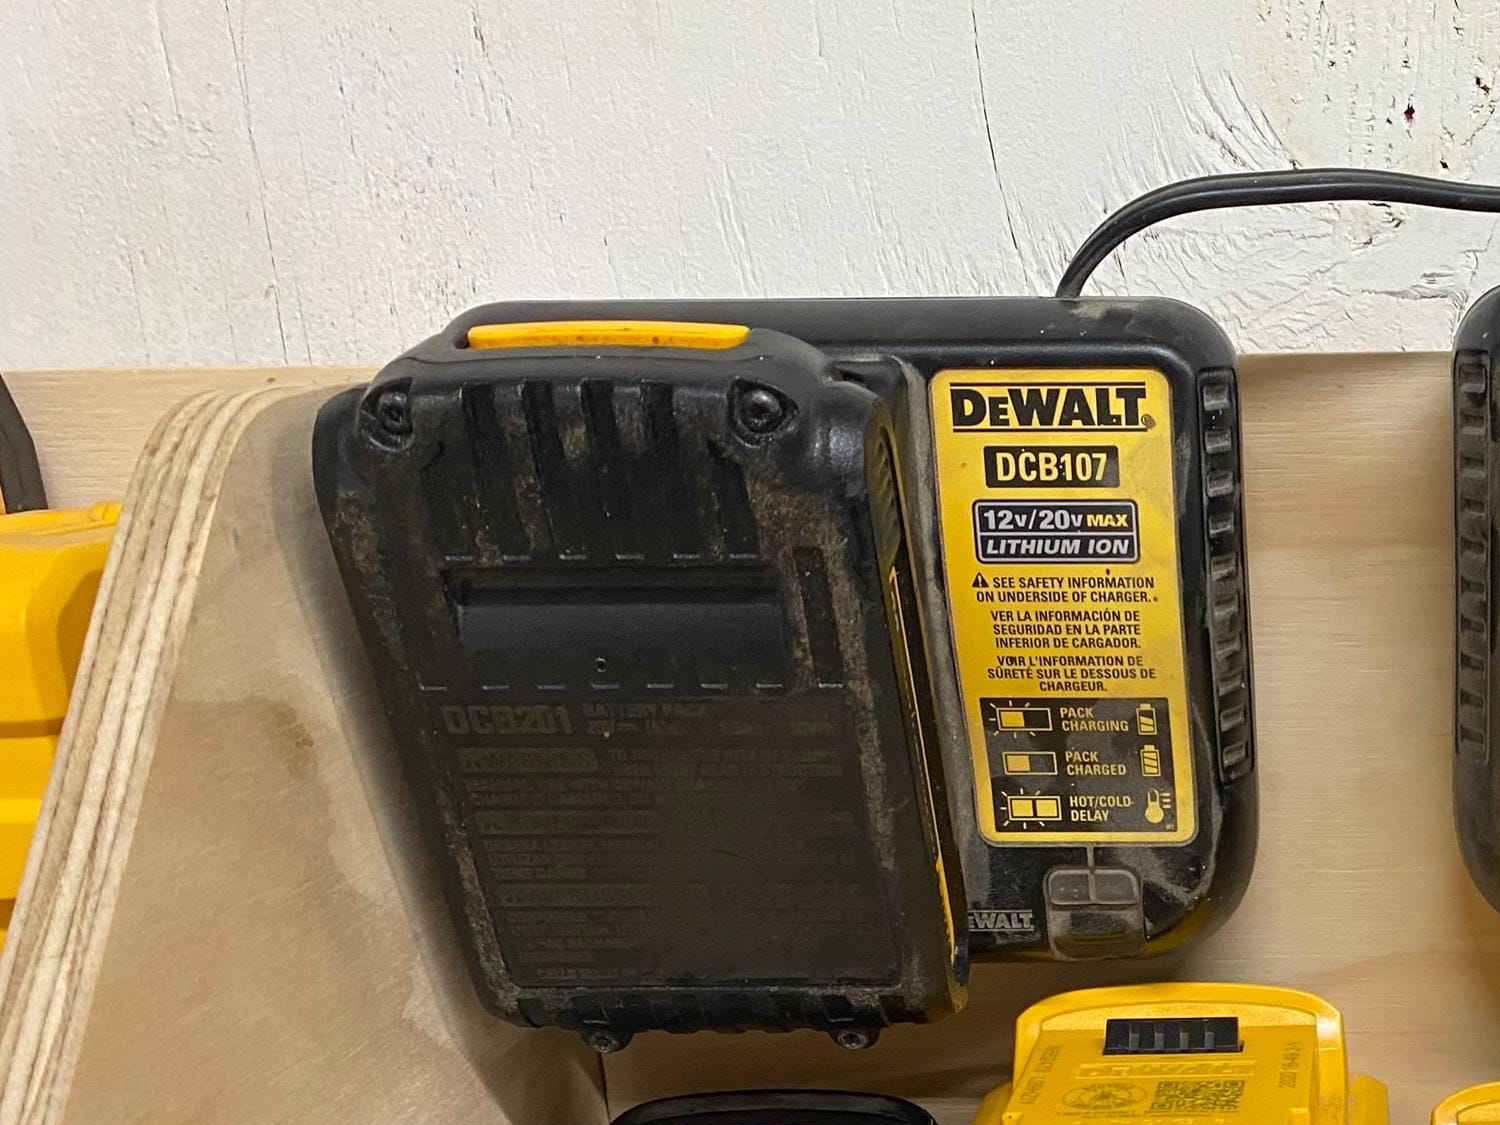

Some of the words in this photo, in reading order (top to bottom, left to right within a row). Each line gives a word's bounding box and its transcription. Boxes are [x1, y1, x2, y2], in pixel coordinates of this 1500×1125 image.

[995, 452, 1107, 482] DCB107
[1087, 513, 1128, 527] MAX
[986, 538, 1080, 555] LITHIUM
[1087, 538, 1129, 555] ION
[993, 577, 1015, 588] SEE
[1019, 577, 1064, 588] SAFETY
[1068, 577, 1154, 588] INFORMATION
[977, 591, 994, 602] ON
[998, 591, 1068, 602] UNDERSIDE
[1072, 591, 1088, 602] OF
[1090, 591, 1151, 602] CHARGER.
[991, 610, 1013, 622] VER
[1017, 610, 1031, 622] LA
[1035, 607, 1121, 622] INFORMACIÓN
[1125, 610, 1140, 621] DE
[993, 624, 1062, 635] SEGURIDAD
[1066, 624, 1082, 635] EN
[1085, 624, 1100, 635] LA
[1104, 624, 1141, 635] PARTE
[995, 638, 1050, 648] INFERIOR
[1054, 638, 1069, 648] DE
[1072, 638, 1141, 648] CARGADOR.
[997, 656, 1025, 666] VOIR
[1029, 656, 1124, 666] L'INFORMATION
[1128, 656, 1143, 666] DE
[988, 665, 1032, 679] SÛRETÉ
[1037, 669, 1060, 679] SUR
[1064, 669, 1077, 679] LE
[1081, 669, 1137, 679] DESSOUS
[1141, 669, 1156, 679] DE
[1040, 682, 1107, 691] CHARGEUR.
[1060, 708, 1094, 718] PACK
[442, 705, 573, 735] DCB201
[1062, 721, 1129, 731] CHARGING
[1065, 752, 1098, 762] PACK
[1067, 765, 1127, 776] CHARGED
[1070, 796, 1131, 808] HOT/COLD
[1071, 810, 1109, 821] DELAY
[968, 912, 1034, 929] EWALT
